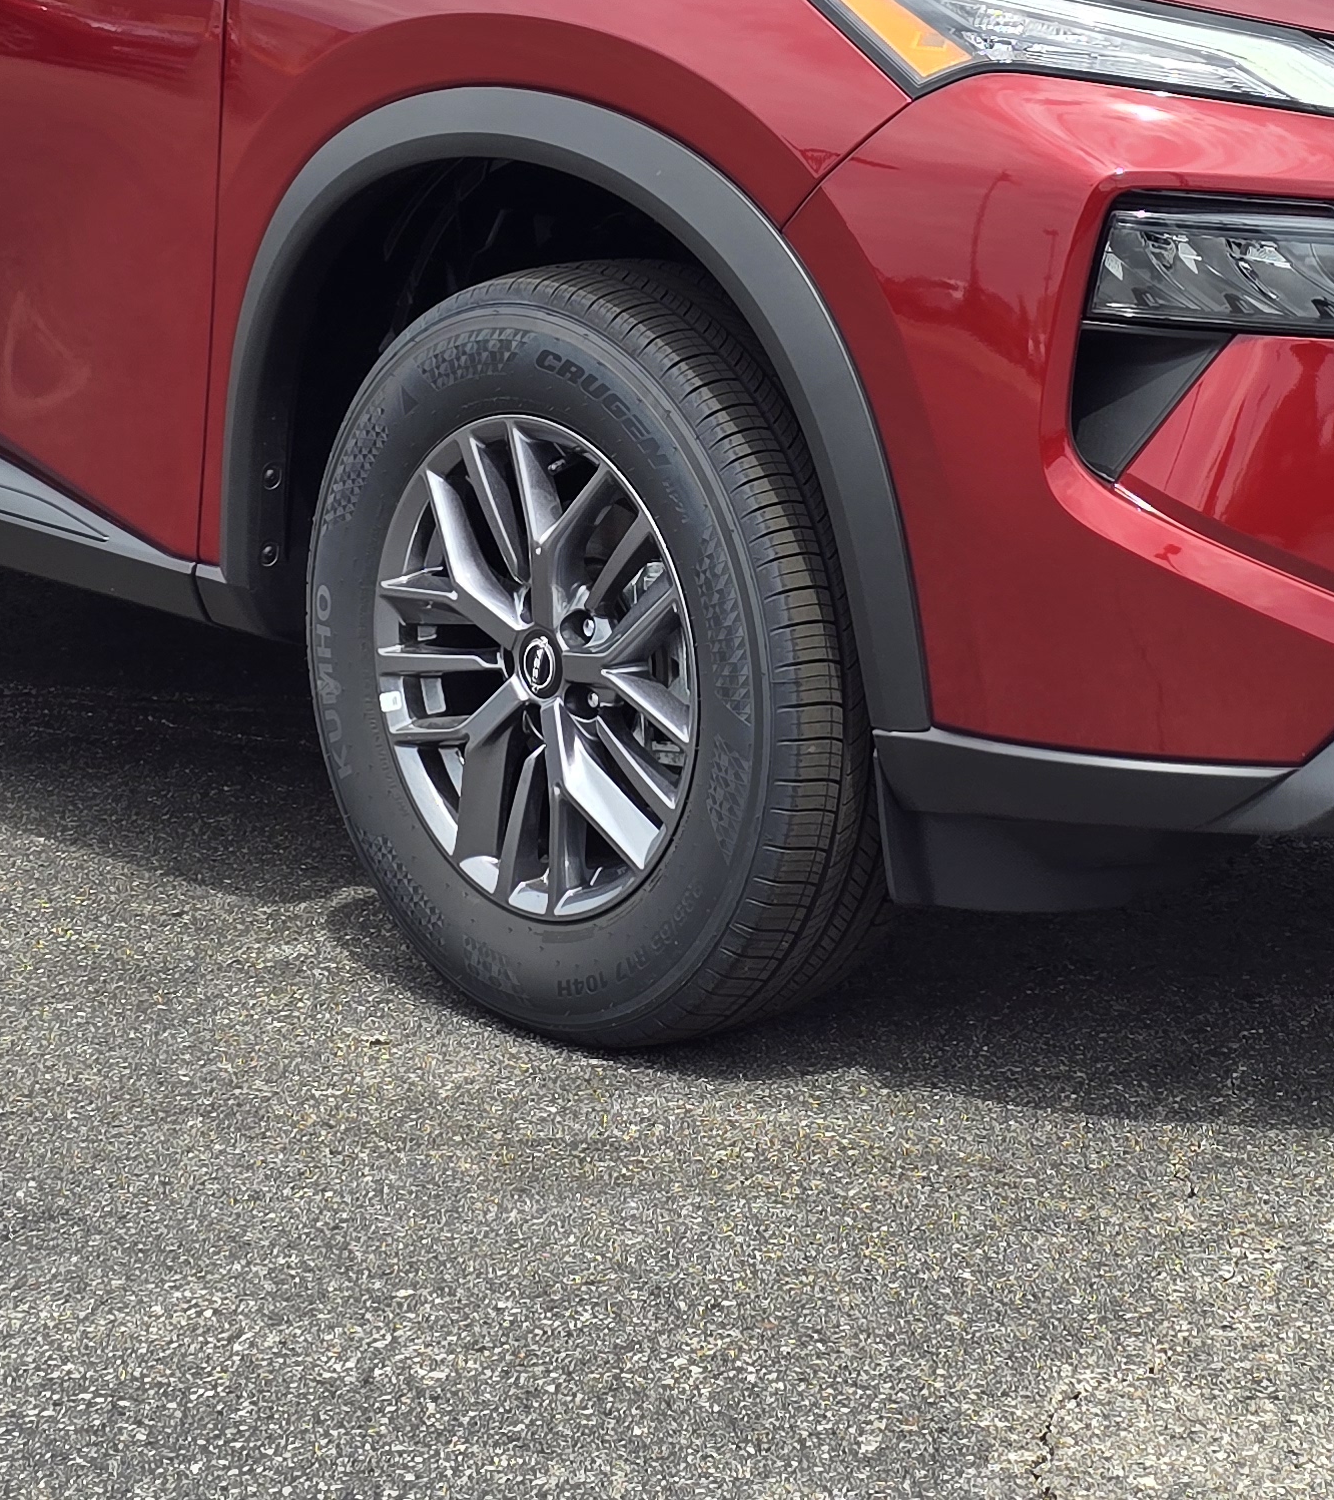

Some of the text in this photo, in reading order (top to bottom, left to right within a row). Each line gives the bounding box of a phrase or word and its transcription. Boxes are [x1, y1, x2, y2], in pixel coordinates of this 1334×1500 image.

[535, 349, 673, 470] CRUGEN
[316, 584, 353, 780] KUMHO
[556, 970, 609, 998] 104H
[615, 943, 652, 985] R17
